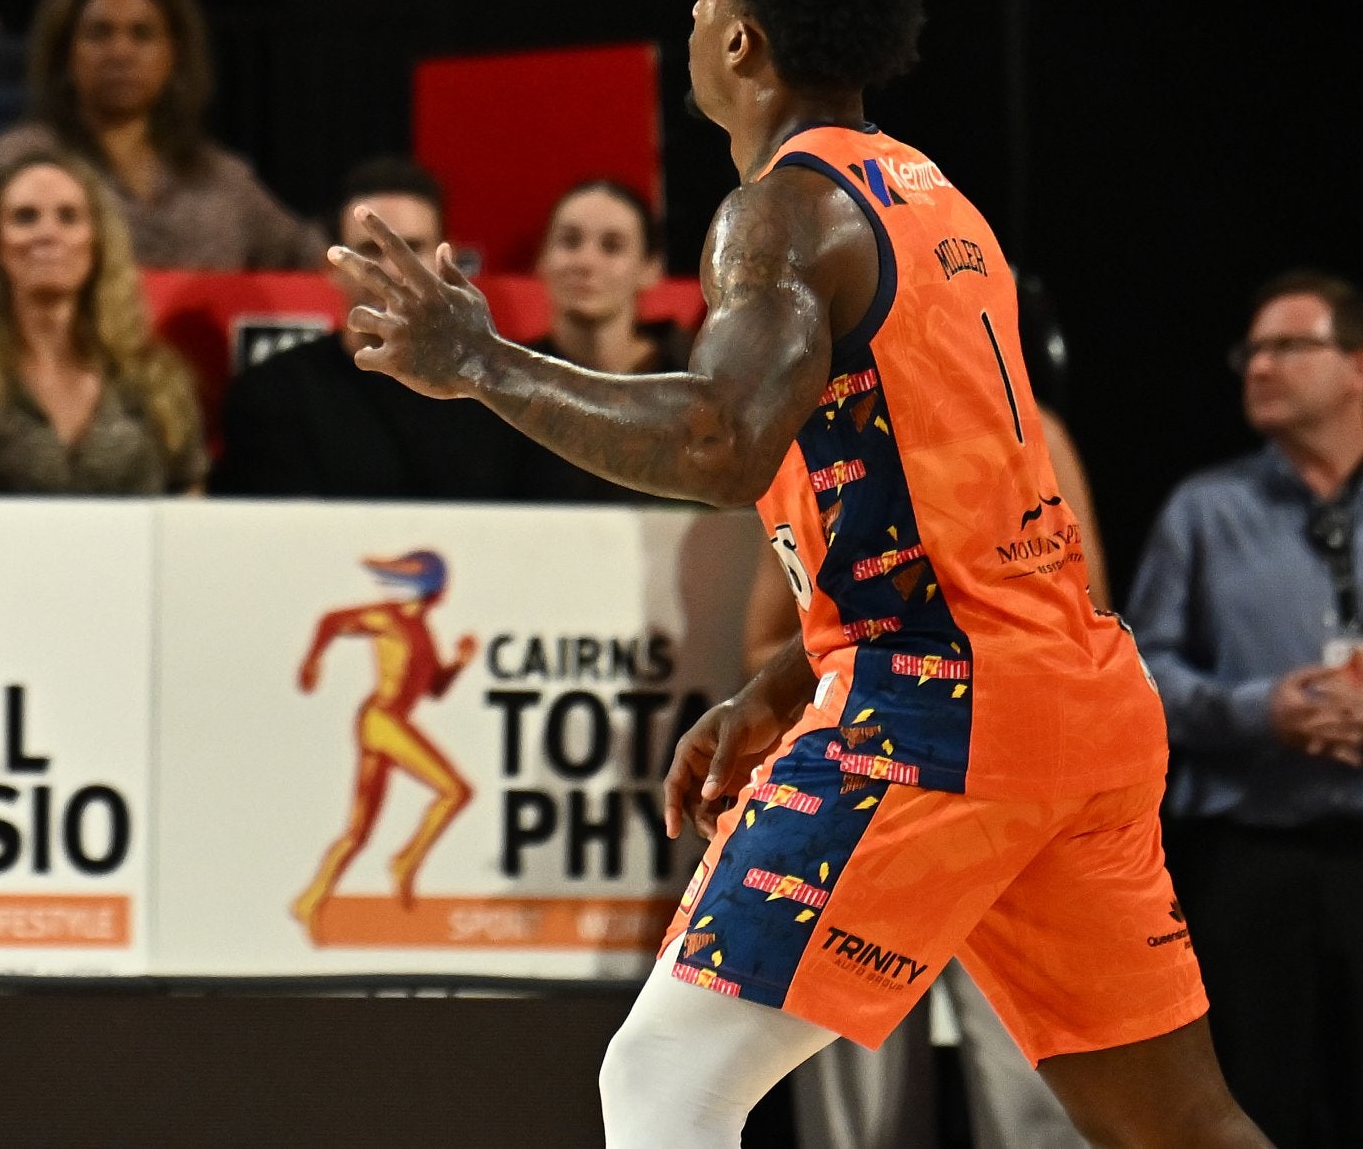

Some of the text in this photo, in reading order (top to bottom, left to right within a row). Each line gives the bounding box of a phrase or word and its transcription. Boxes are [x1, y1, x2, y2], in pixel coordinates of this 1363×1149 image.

[934, 237, 988, 281] MILLER
[982, 310, 1027, 447] 1
[486, 634, 673, 681] CAIRNS
[822, 926, 928, 985] TRINITY
